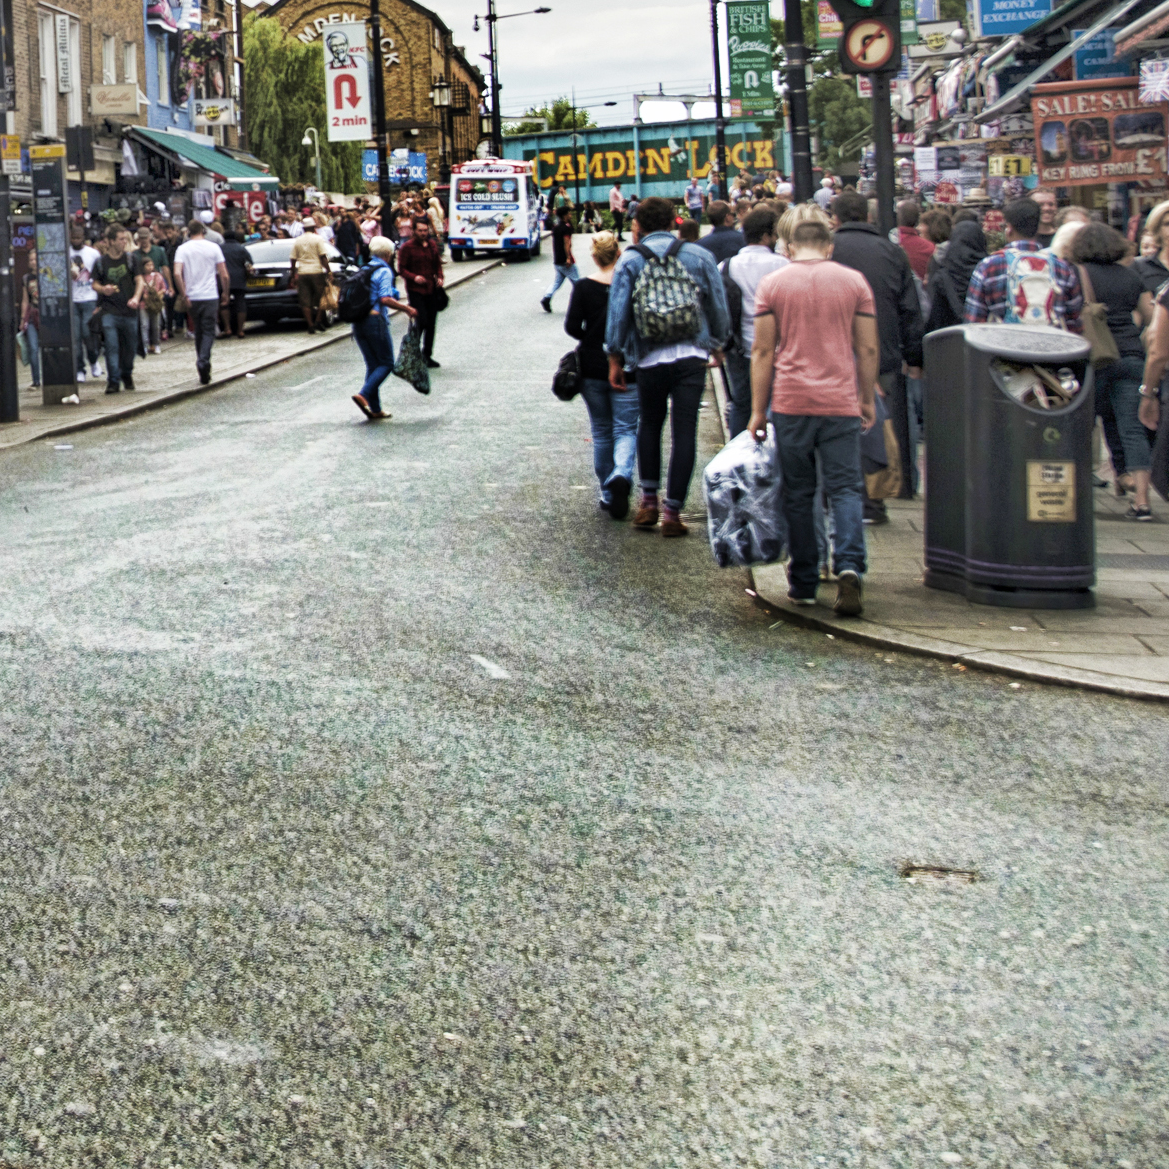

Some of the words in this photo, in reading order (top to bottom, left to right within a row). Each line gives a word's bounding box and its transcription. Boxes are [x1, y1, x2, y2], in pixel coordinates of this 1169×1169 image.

[729, 5, 767, 14] BRITISH
[992, 0, 1037, 11] MONEY
[730, 12, 767, 27] FISH
[983, 9, 1049, 24] EXCHANGE
[730, 26, 738, 34] &
[739, 25, 767, 34] CHIPS
[732, 56, 766, 64] Restaurant
[1037, 95, 1097, 118] SALE!
[332, 117, 340, 127] 2
[342, 115, 368, 127] min
[532, 147, 671, 188] CAMDEN
[685, 139, 774, 179] LOCK
[1003, 158, 1022, 174] £1
[1135, 147, 1168, 174] £1
[1042, 167, 1066, 181] KEY
[1068, 165, 1099, 179] RING
[1101, 162, 1135, 176] FROM
[460, 193, 472, 201] ICE
[473, 193, 490, 201] COLD
[491, 193, 513, 201] SLUSH
